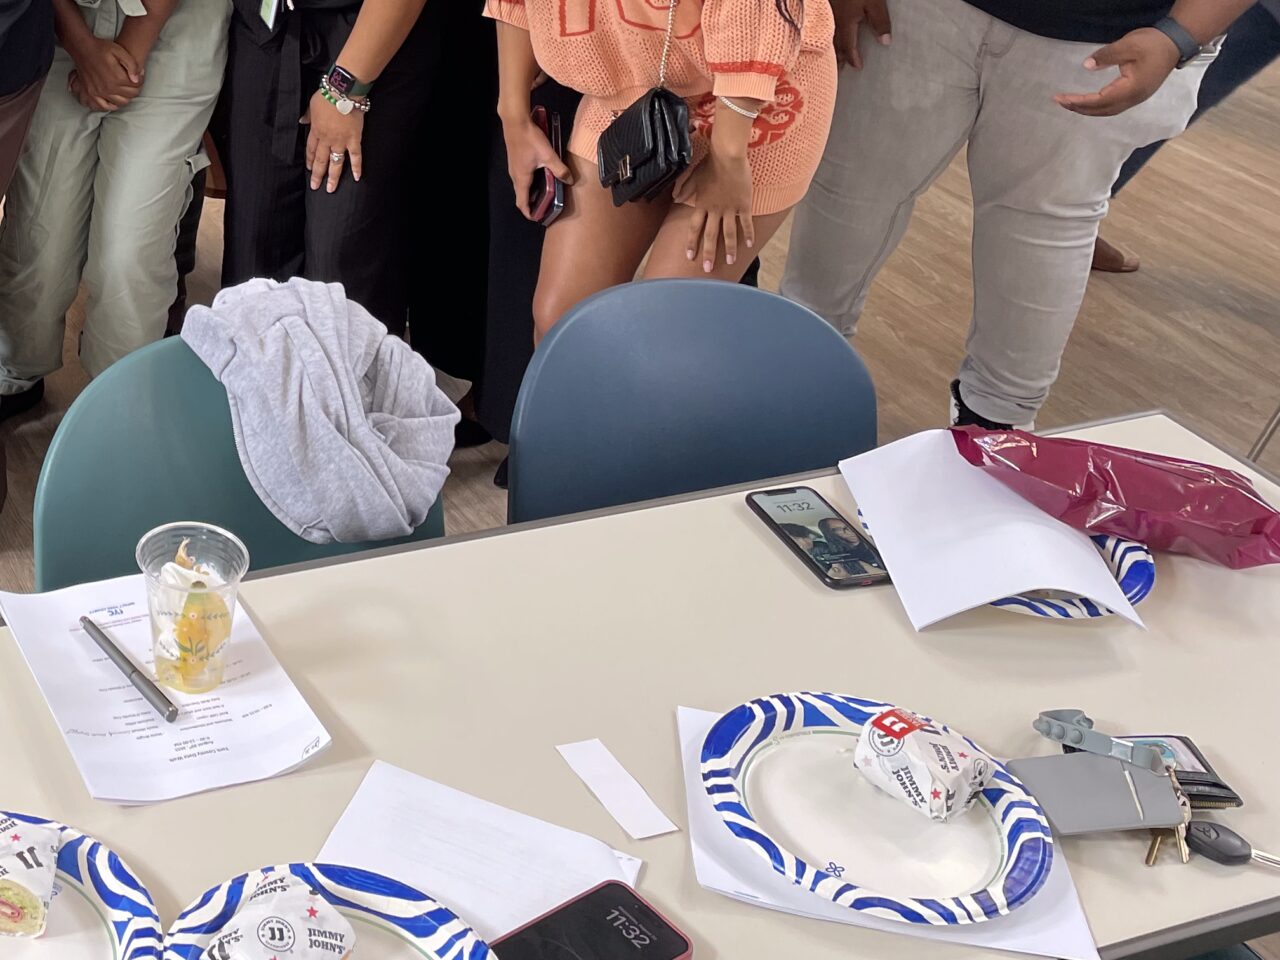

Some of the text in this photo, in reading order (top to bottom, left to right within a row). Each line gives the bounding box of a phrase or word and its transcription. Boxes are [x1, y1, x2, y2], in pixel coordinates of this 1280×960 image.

[776, 501, 816, 513] 11:32
[892, 768, 922, 809] JOHN'S
[900, 765, 927, 805] JIMMY
[307, 927, 345, 943] JIMMY
[605, 908, 651, 949] 11:32
[308, 938, 345, 955] JOHN'S
